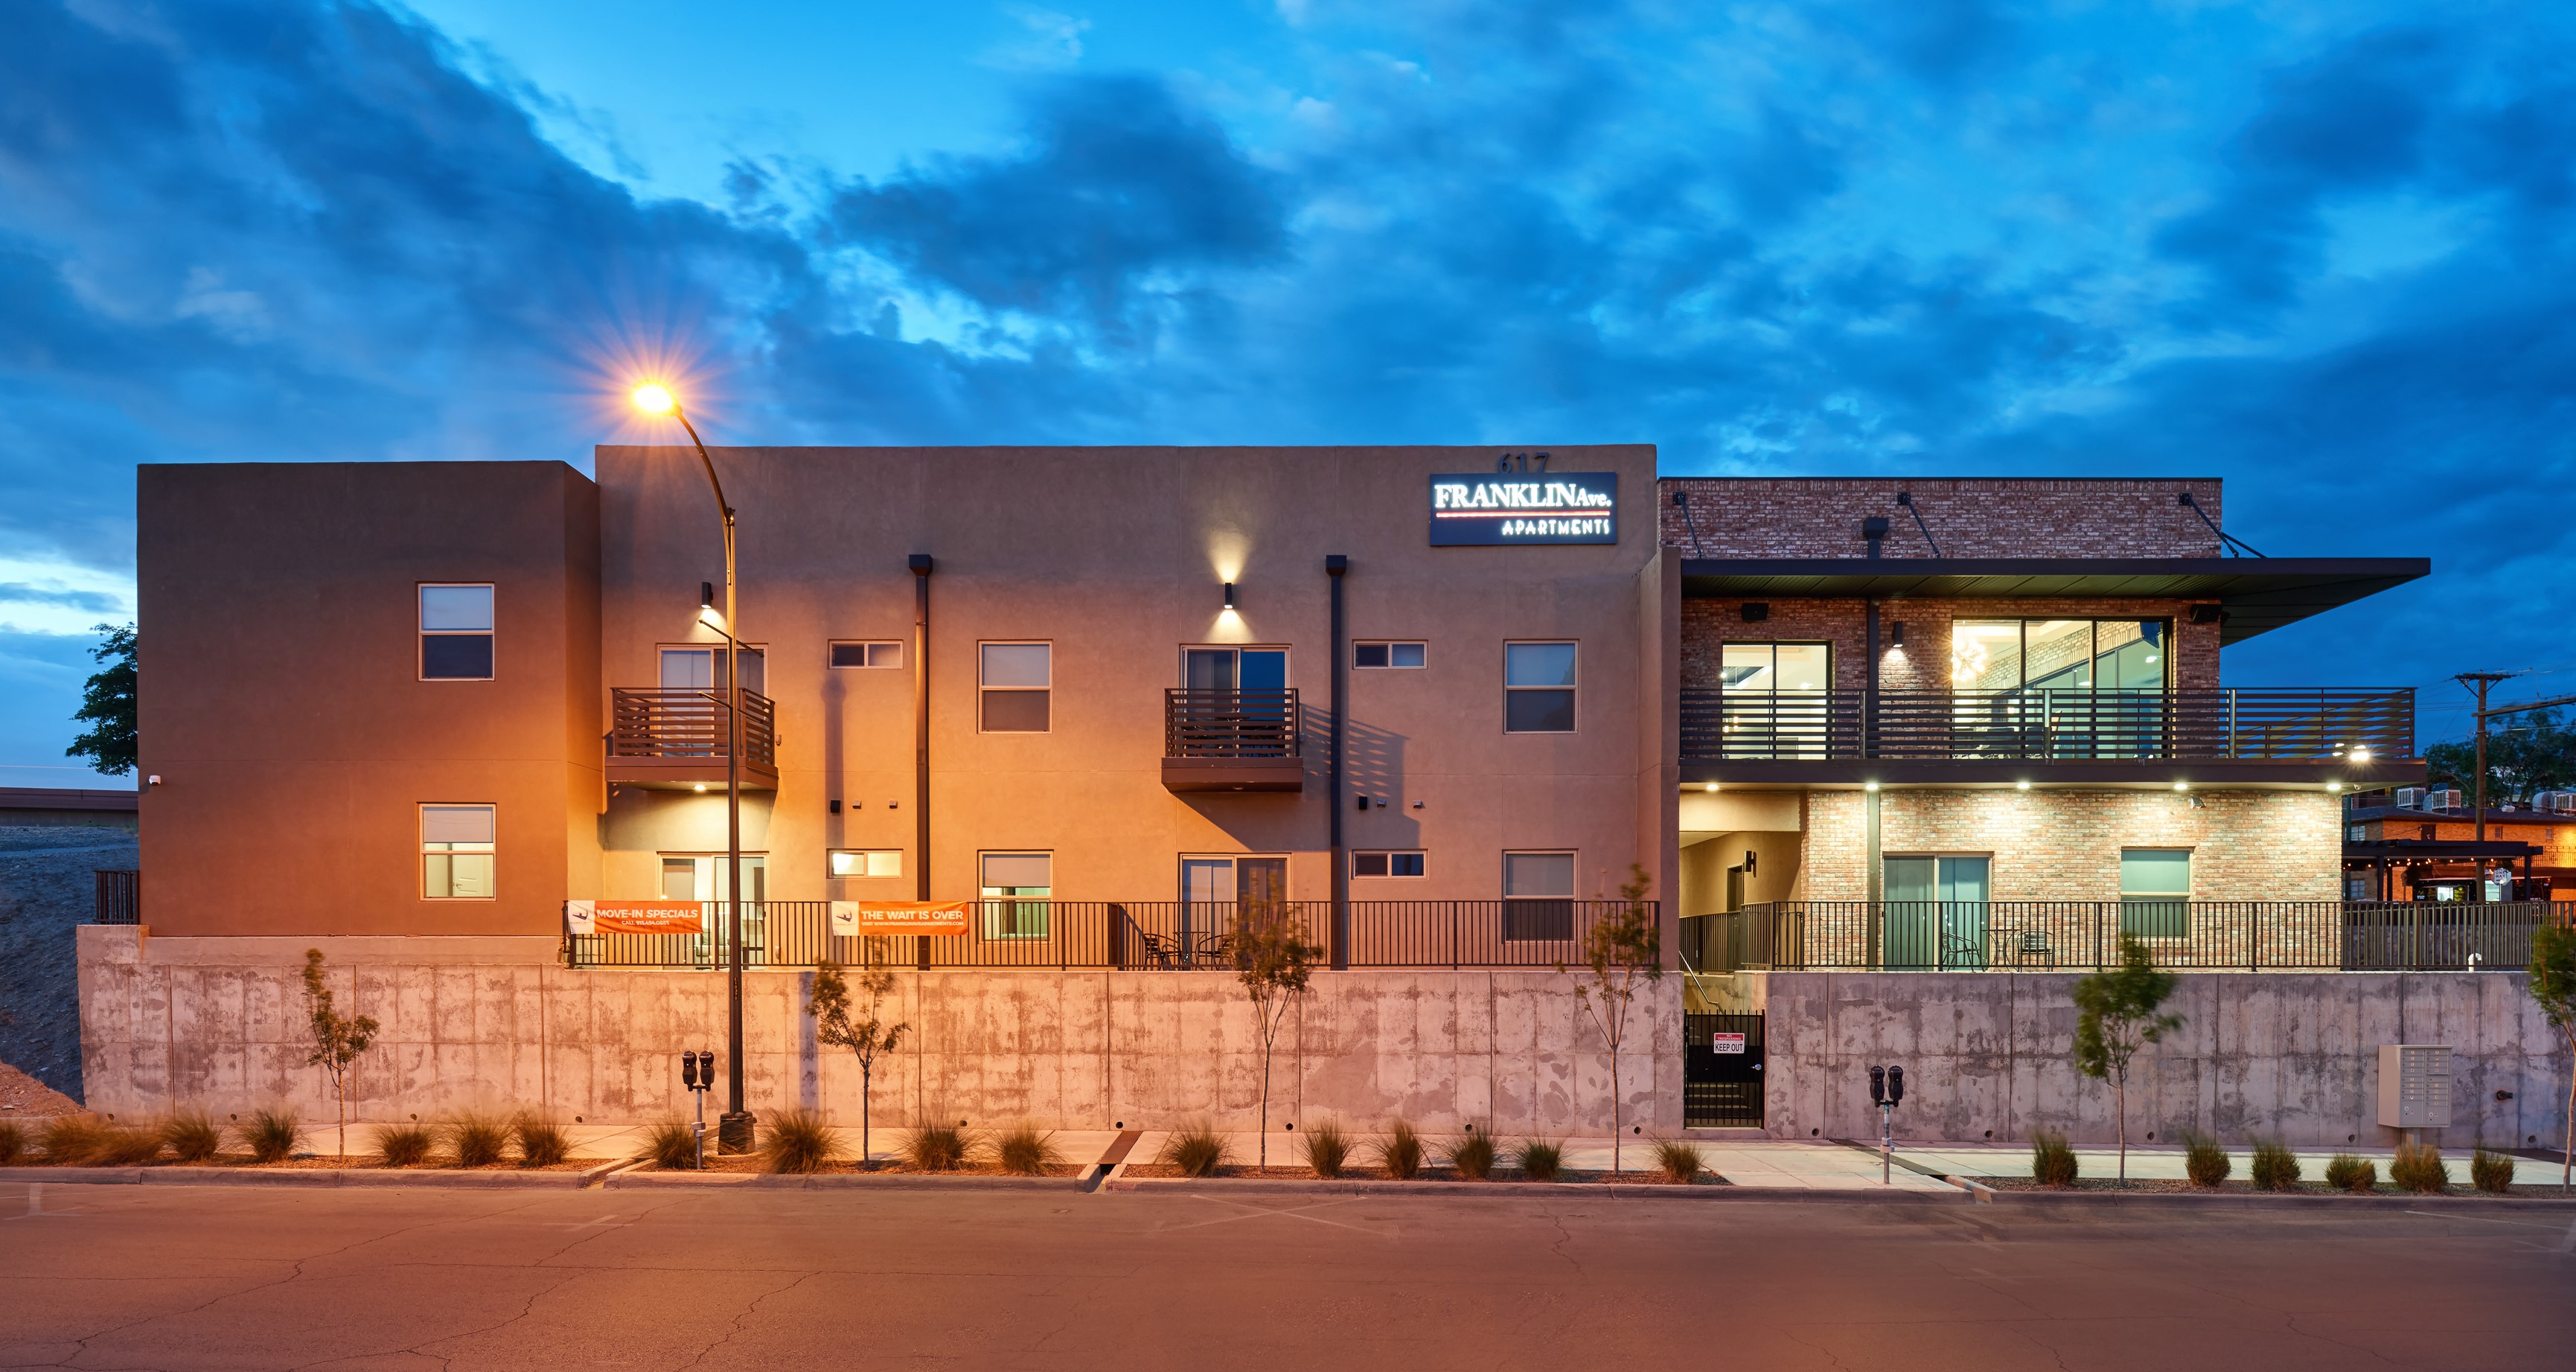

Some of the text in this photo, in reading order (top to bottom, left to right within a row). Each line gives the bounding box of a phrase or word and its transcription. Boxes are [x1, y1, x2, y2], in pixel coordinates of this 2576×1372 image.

[1498, 452, 1549, 473] 617
[1434, 483, 1612, 508] FRANKLIN Ave.
[1501, 519, 1610, 536] APARTMENTS
[596, 909, 698, 918] MOVE-IN SPECIALS
[861, 911, 964, 920] THE WAIT IS OVER
[1715, 1043, 1743, 1052] KEEP OUT
